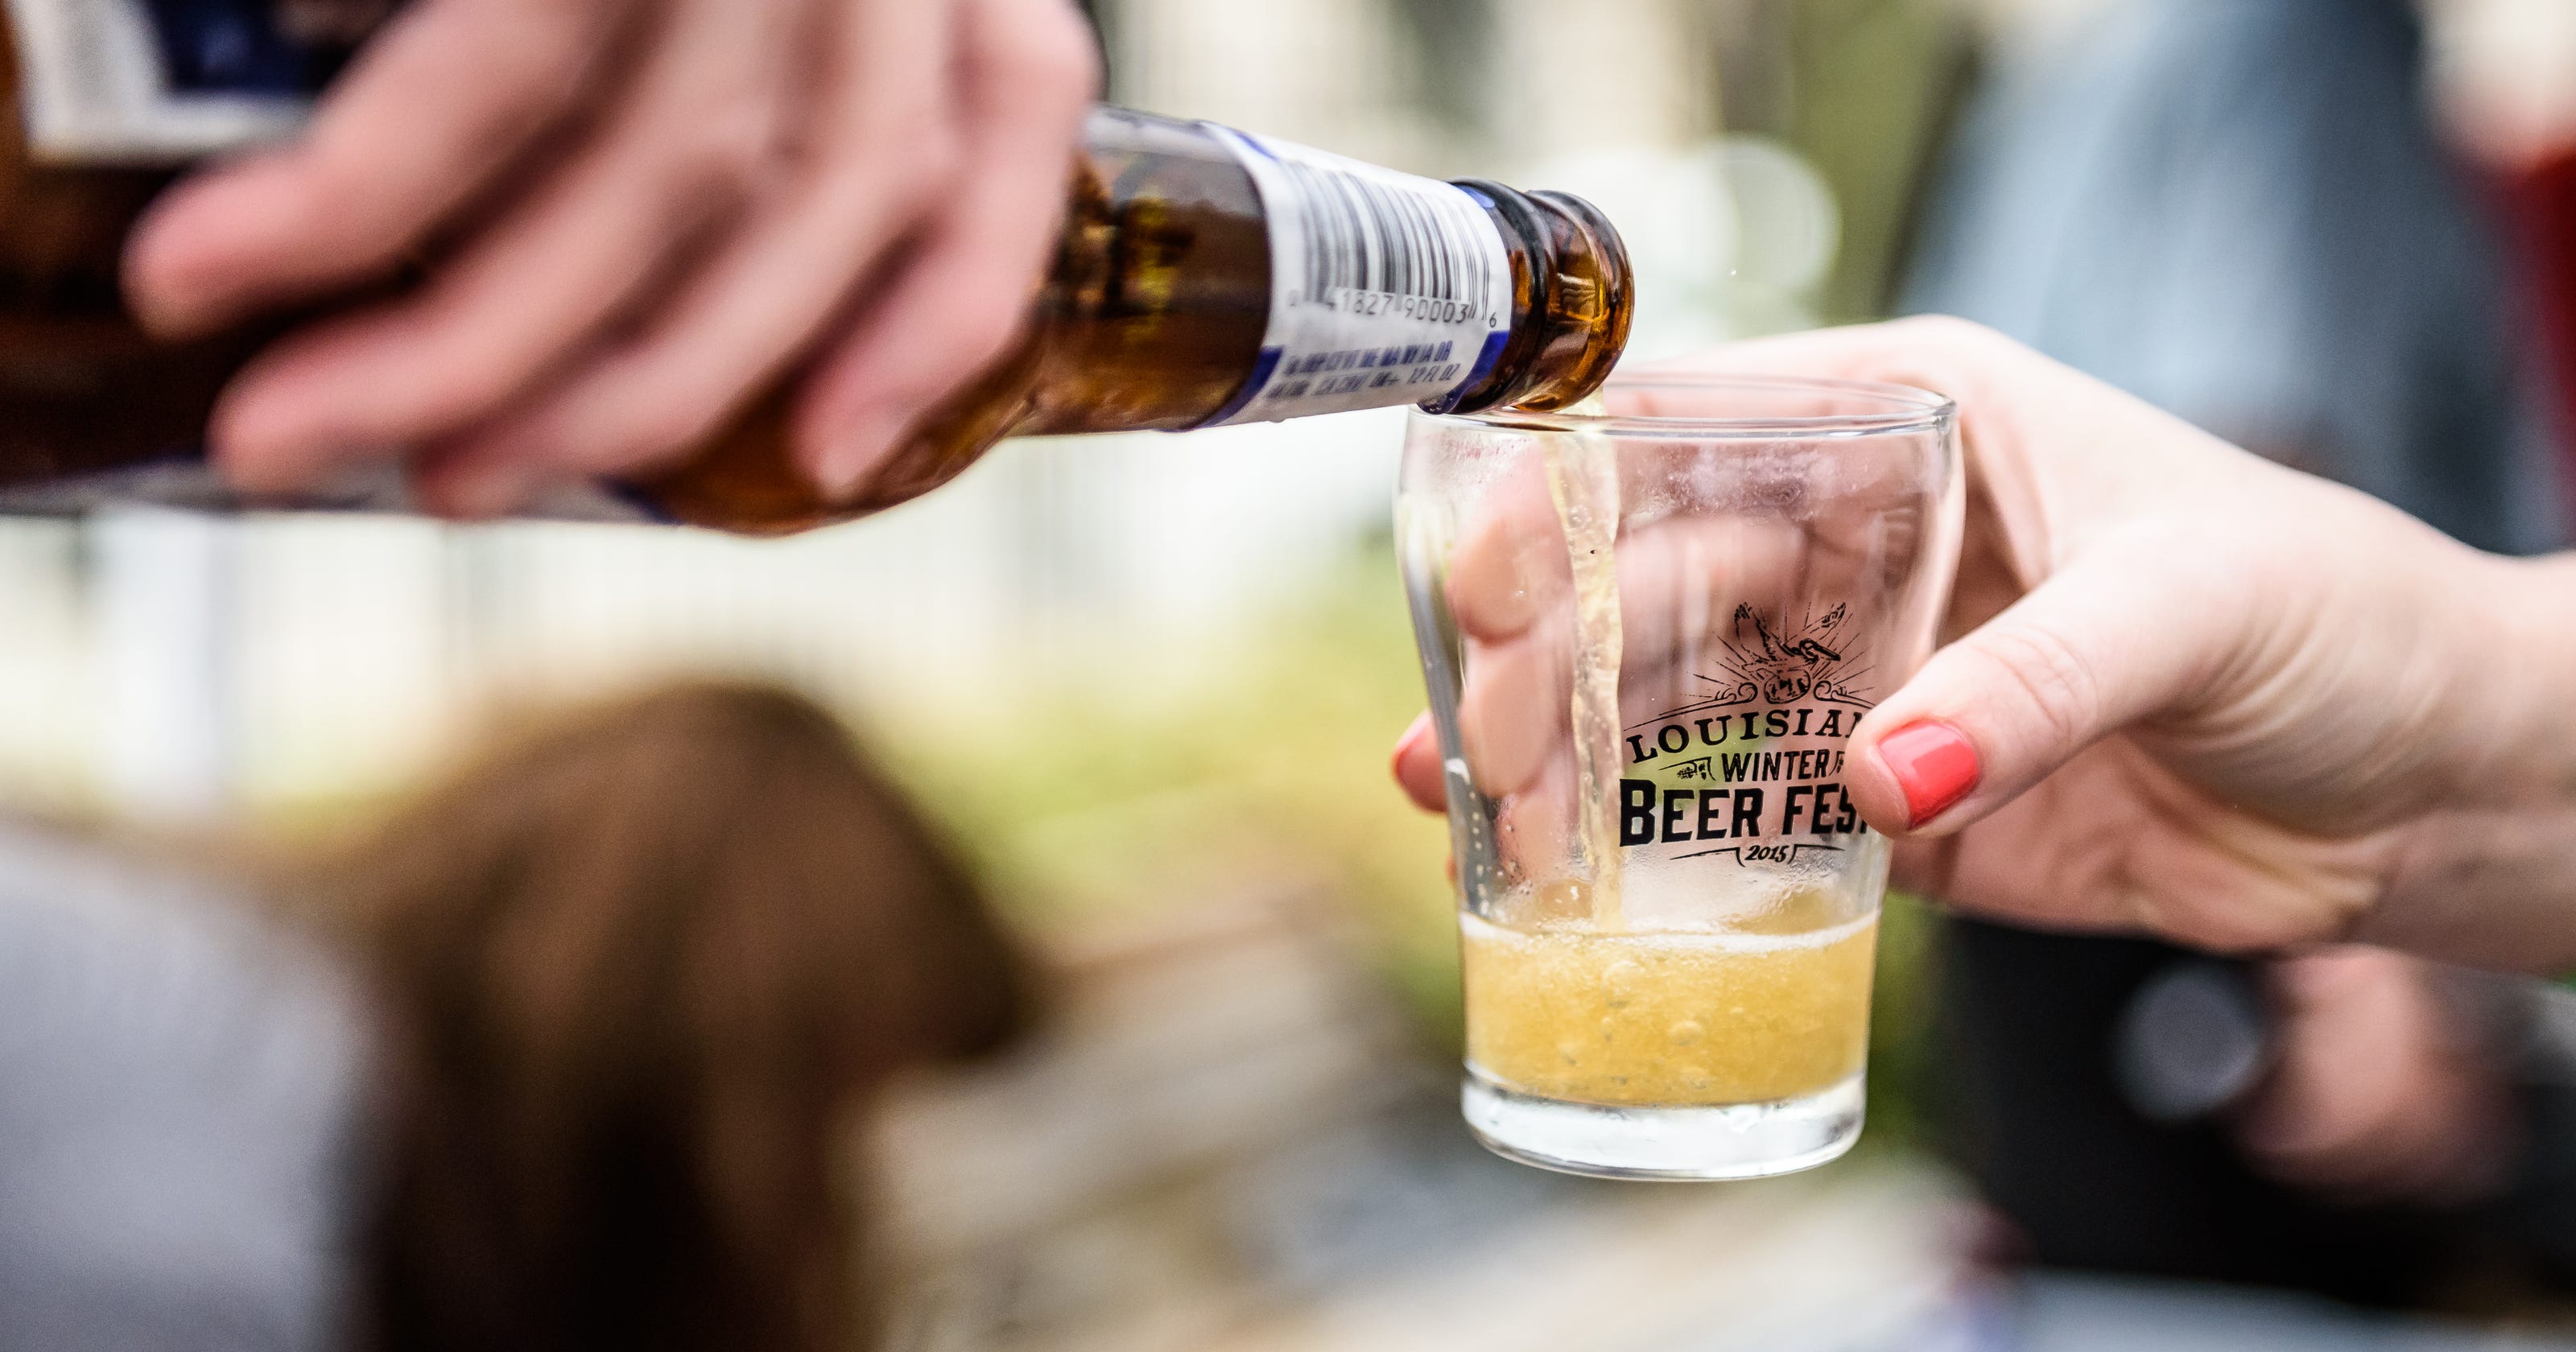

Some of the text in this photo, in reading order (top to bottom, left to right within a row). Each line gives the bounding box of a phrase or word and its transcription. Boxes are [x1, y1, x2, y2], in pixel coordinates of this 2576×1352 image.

[1404, 297, 1469, 324] 90003
[1488, 311, 1497, 328] 6
[1406, 366, 1426, 385] 12
[1439, 362, 1461, 381] OZ
[1625, 708, 1864, 765] LOUISIA
[1721, 748, 1831, 783] WINTER
[1619, 778, 1868, 847] BEER FES
